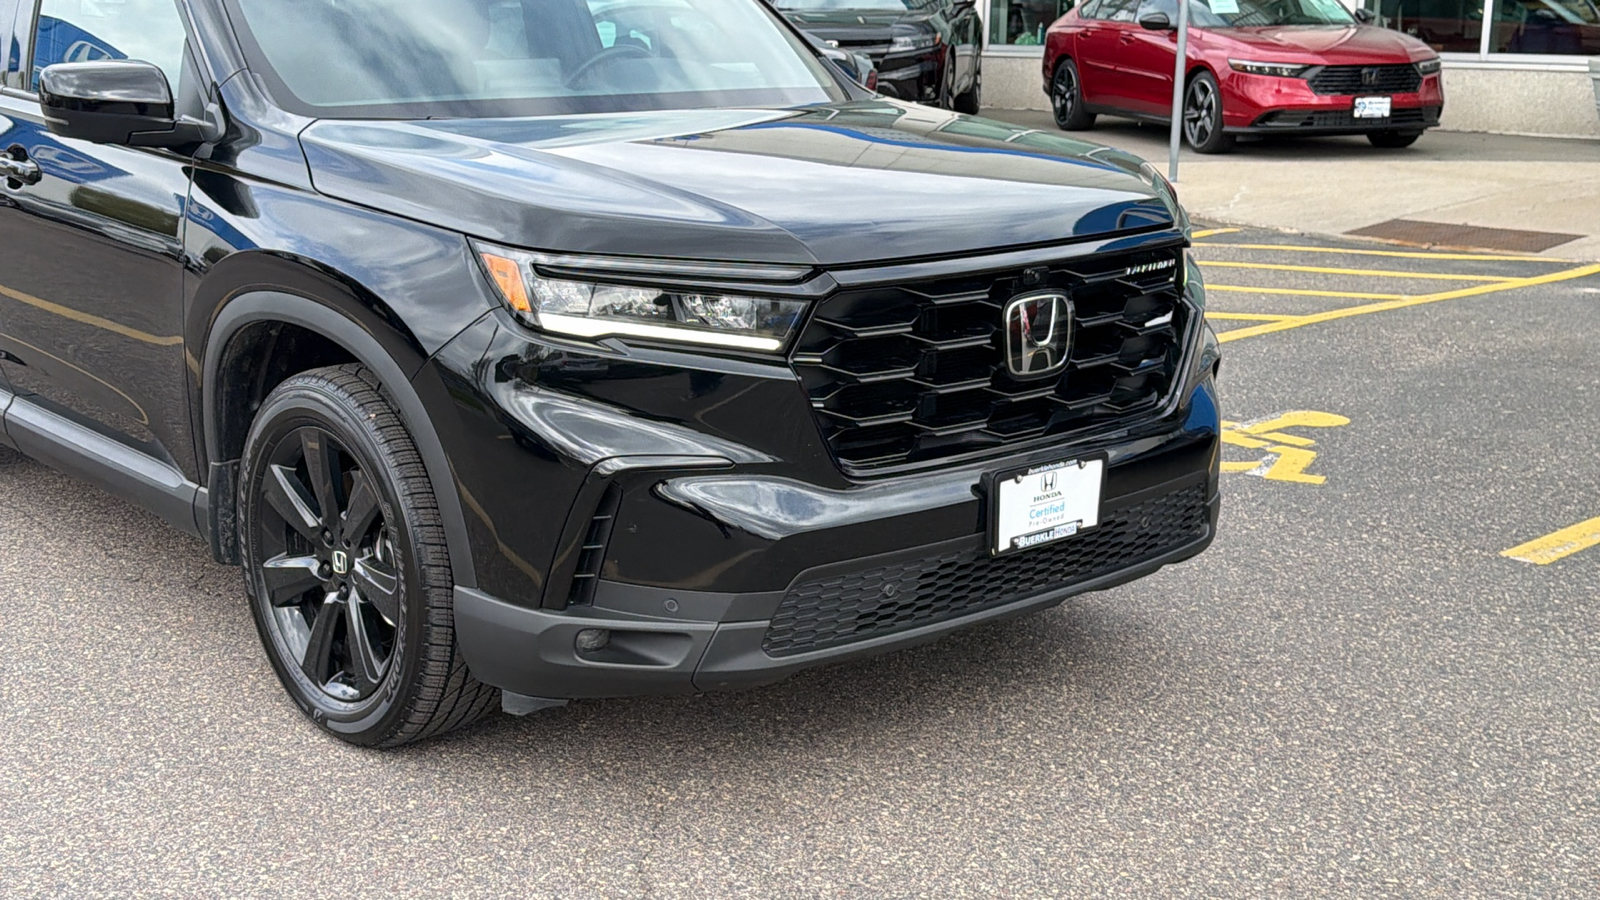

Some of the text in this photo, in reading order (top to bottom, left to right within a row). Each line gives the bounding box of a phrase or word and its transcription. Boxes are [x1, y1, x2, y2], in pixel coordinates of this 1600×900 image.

[1033, 491, 1062, 502] HONDA
[1029, 501, 1065, 519] Certified
[1029, 513, 1064, 527] Pre-Owned
[1019, 525, 1075, 546] BUERKLE HONDA
